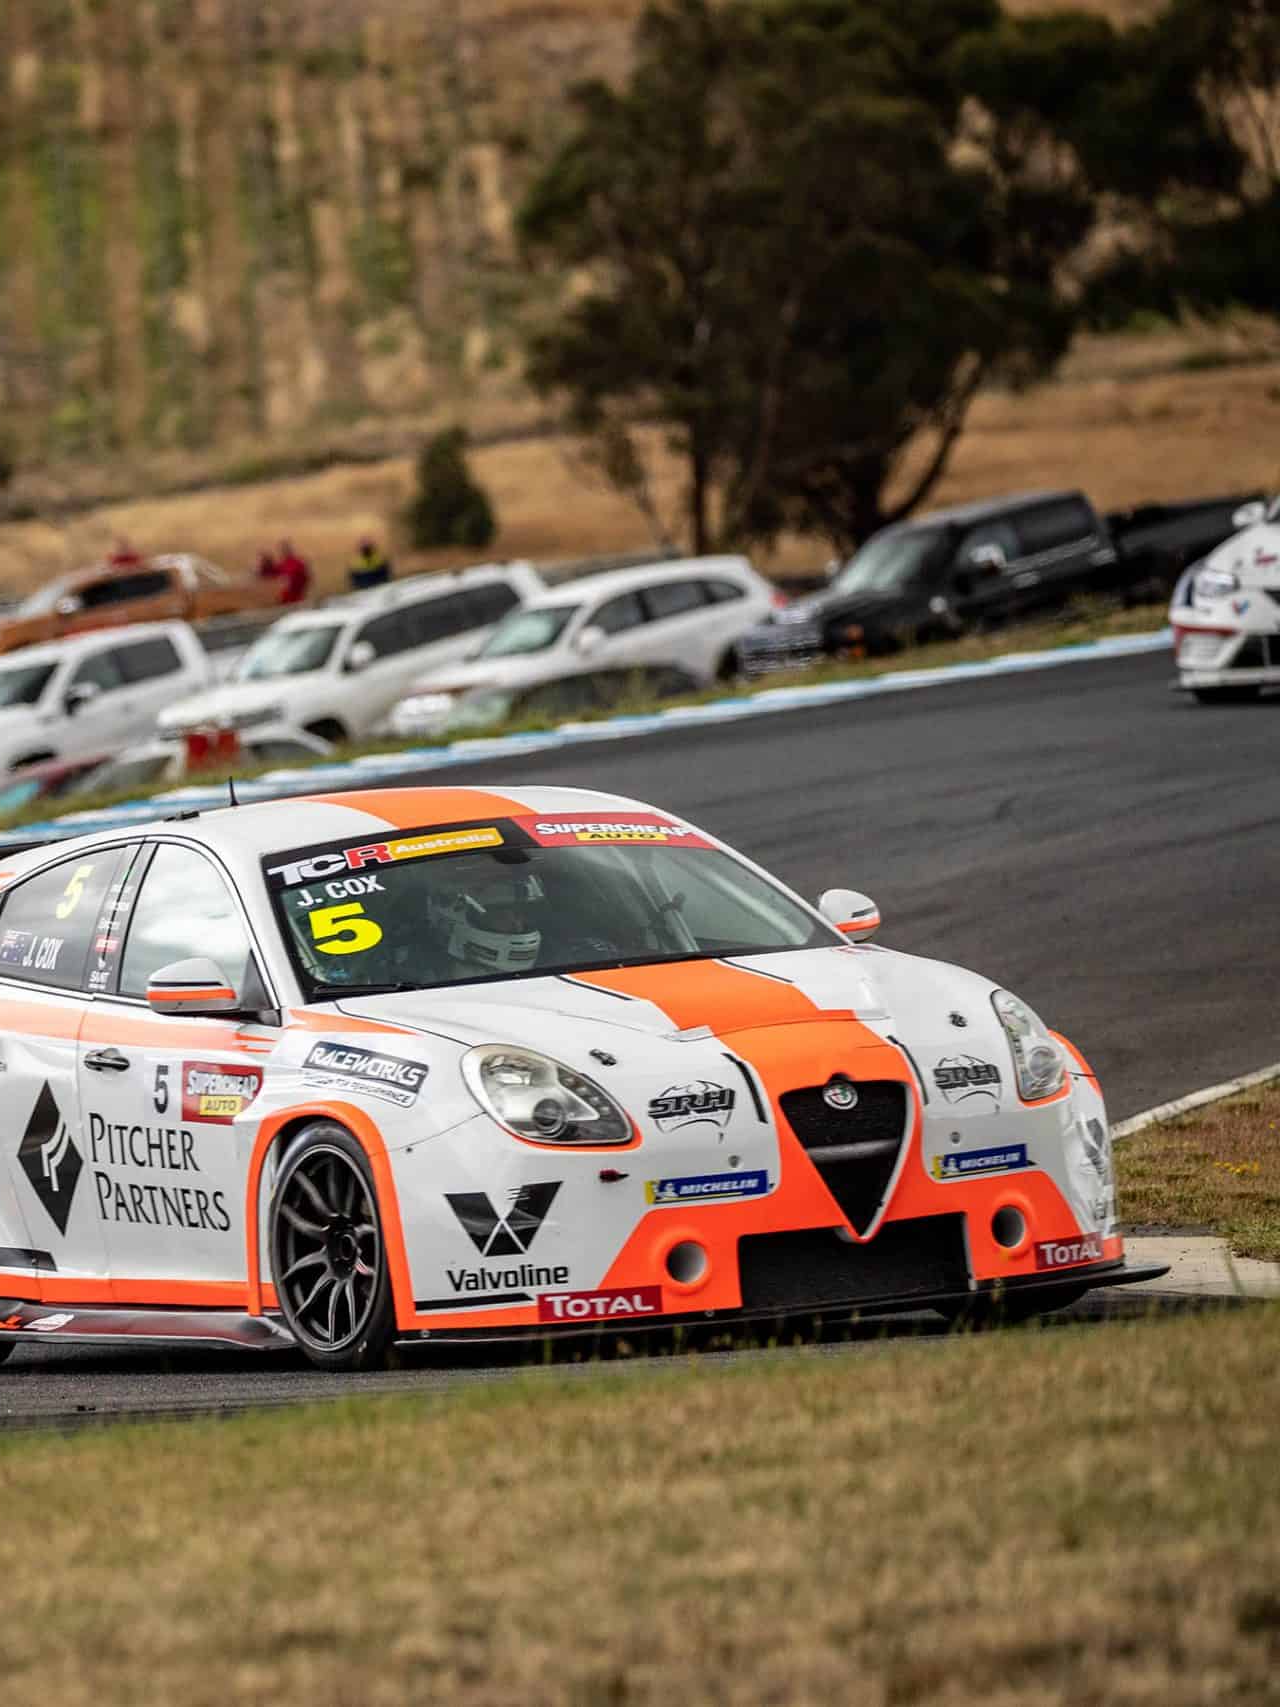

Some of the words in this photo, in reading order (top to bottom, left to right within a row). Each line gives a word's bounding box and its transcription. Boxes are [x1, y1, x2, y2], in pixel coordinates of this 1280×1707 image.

[535, 823, 693, 837] SUPERCHEAP
[589, 832, 657, 840] AUTO
[267, 843, 393, 886] TCR
[395, 833, 496, 854] Australia
[55, 864, 96, 920] 5
[295, 888, 323, 908] J.
[325, 874, 386, 899] COX
[308, 901, 384, 956] 5
[35, 937, 65, 970] COX
[309, 1046, 424, 1087] RACEWORKS
[153, 1065, 169, 1114] 5
[204, 1099, 237, 1112] AUTO
[89, 1112, 200, 1171] PITCHER
[959, 1152, 1021, 1169] MICHELIN
[94, 1170, 231, 1232] PARTNERS
[679, 1179, 760, 1194] MICHELIN
[1039, 1240, 1103, 1266] TOTAL
[446, 1263, 569, 1292] Valvoline
[544, 1295, 655, 1318] TOTAL
